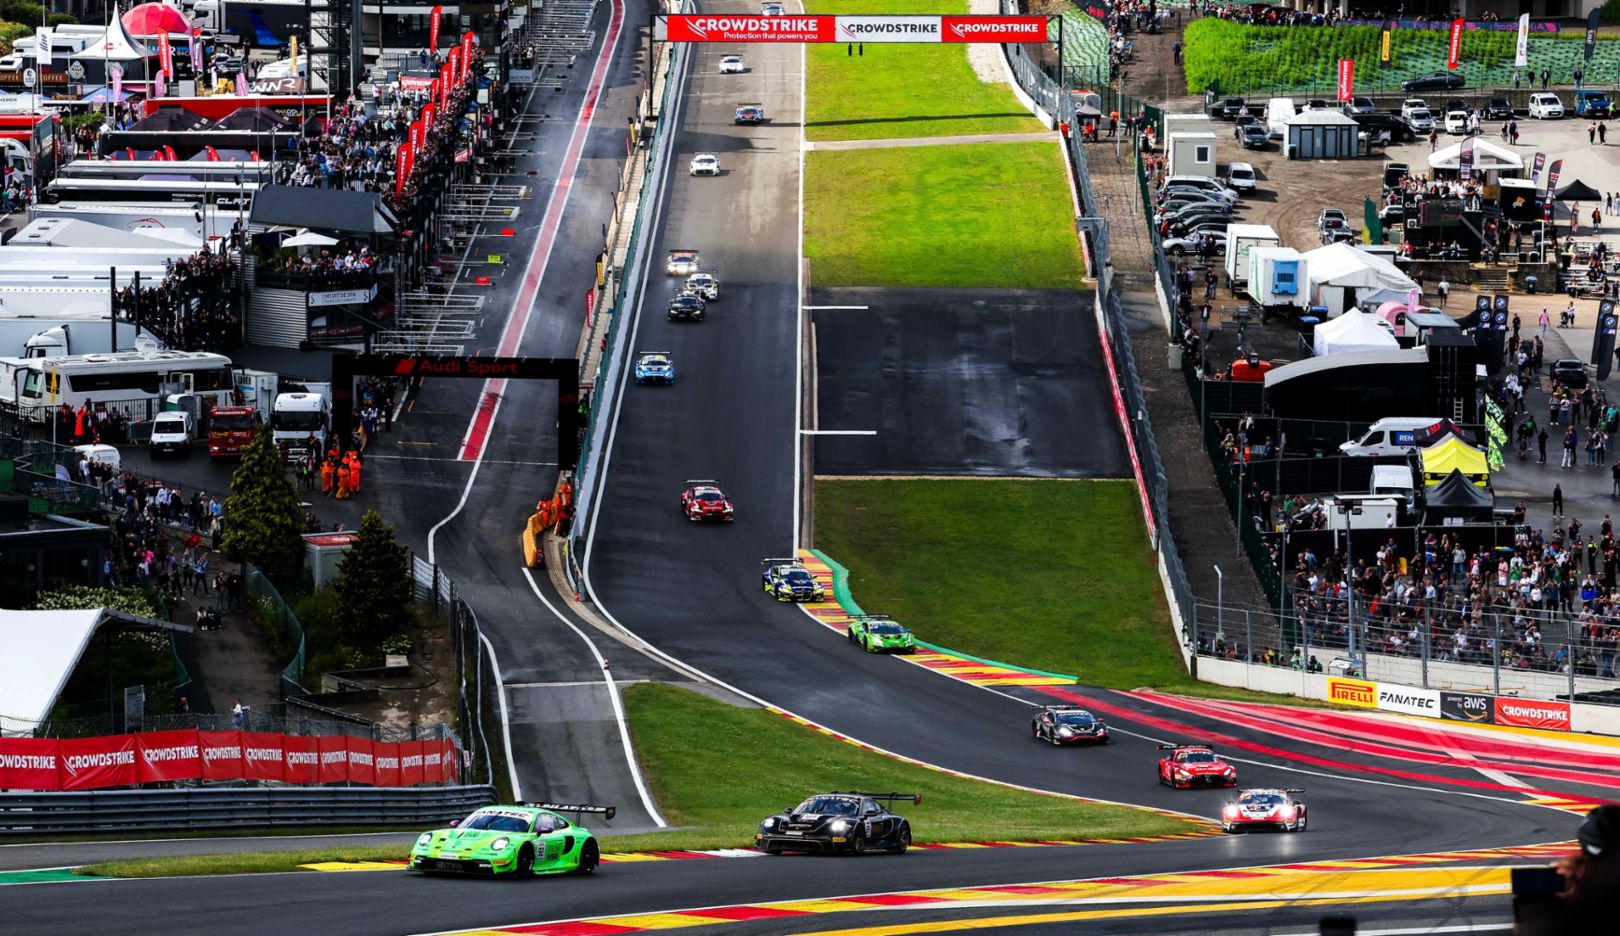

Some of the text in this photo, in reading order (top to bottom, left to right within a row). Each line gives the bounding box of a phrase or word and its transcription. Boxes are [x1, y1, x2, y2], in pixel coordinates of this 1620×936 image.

[695, 19, 818, 32] CROWDSTRIKE
[848, 23, 938, 33] CROWDSTRIKE
[957, 23, 1039, 33] CROWDSTRIKE
[1450, 24, 1460, 64] CROWDSTRIKE
[419, 359, 519, 374] Audi Sport
[1331, 682, 1374, 704] PIRELLI
[1380, 692, 1435, 709] FANATEC
[1464, 696, 1487, 710] aws
[1502, 705, 1568, 720] CROWDSTRIKE
[68, 750, 135, 769] CROWDSTRIKE
[144, 745, 199, 762] CROWDSTRIKE
[204, 746, 241, 760] CROWDSTRIKE
[246, 748, 283, 761] CROWDSTRIKE
